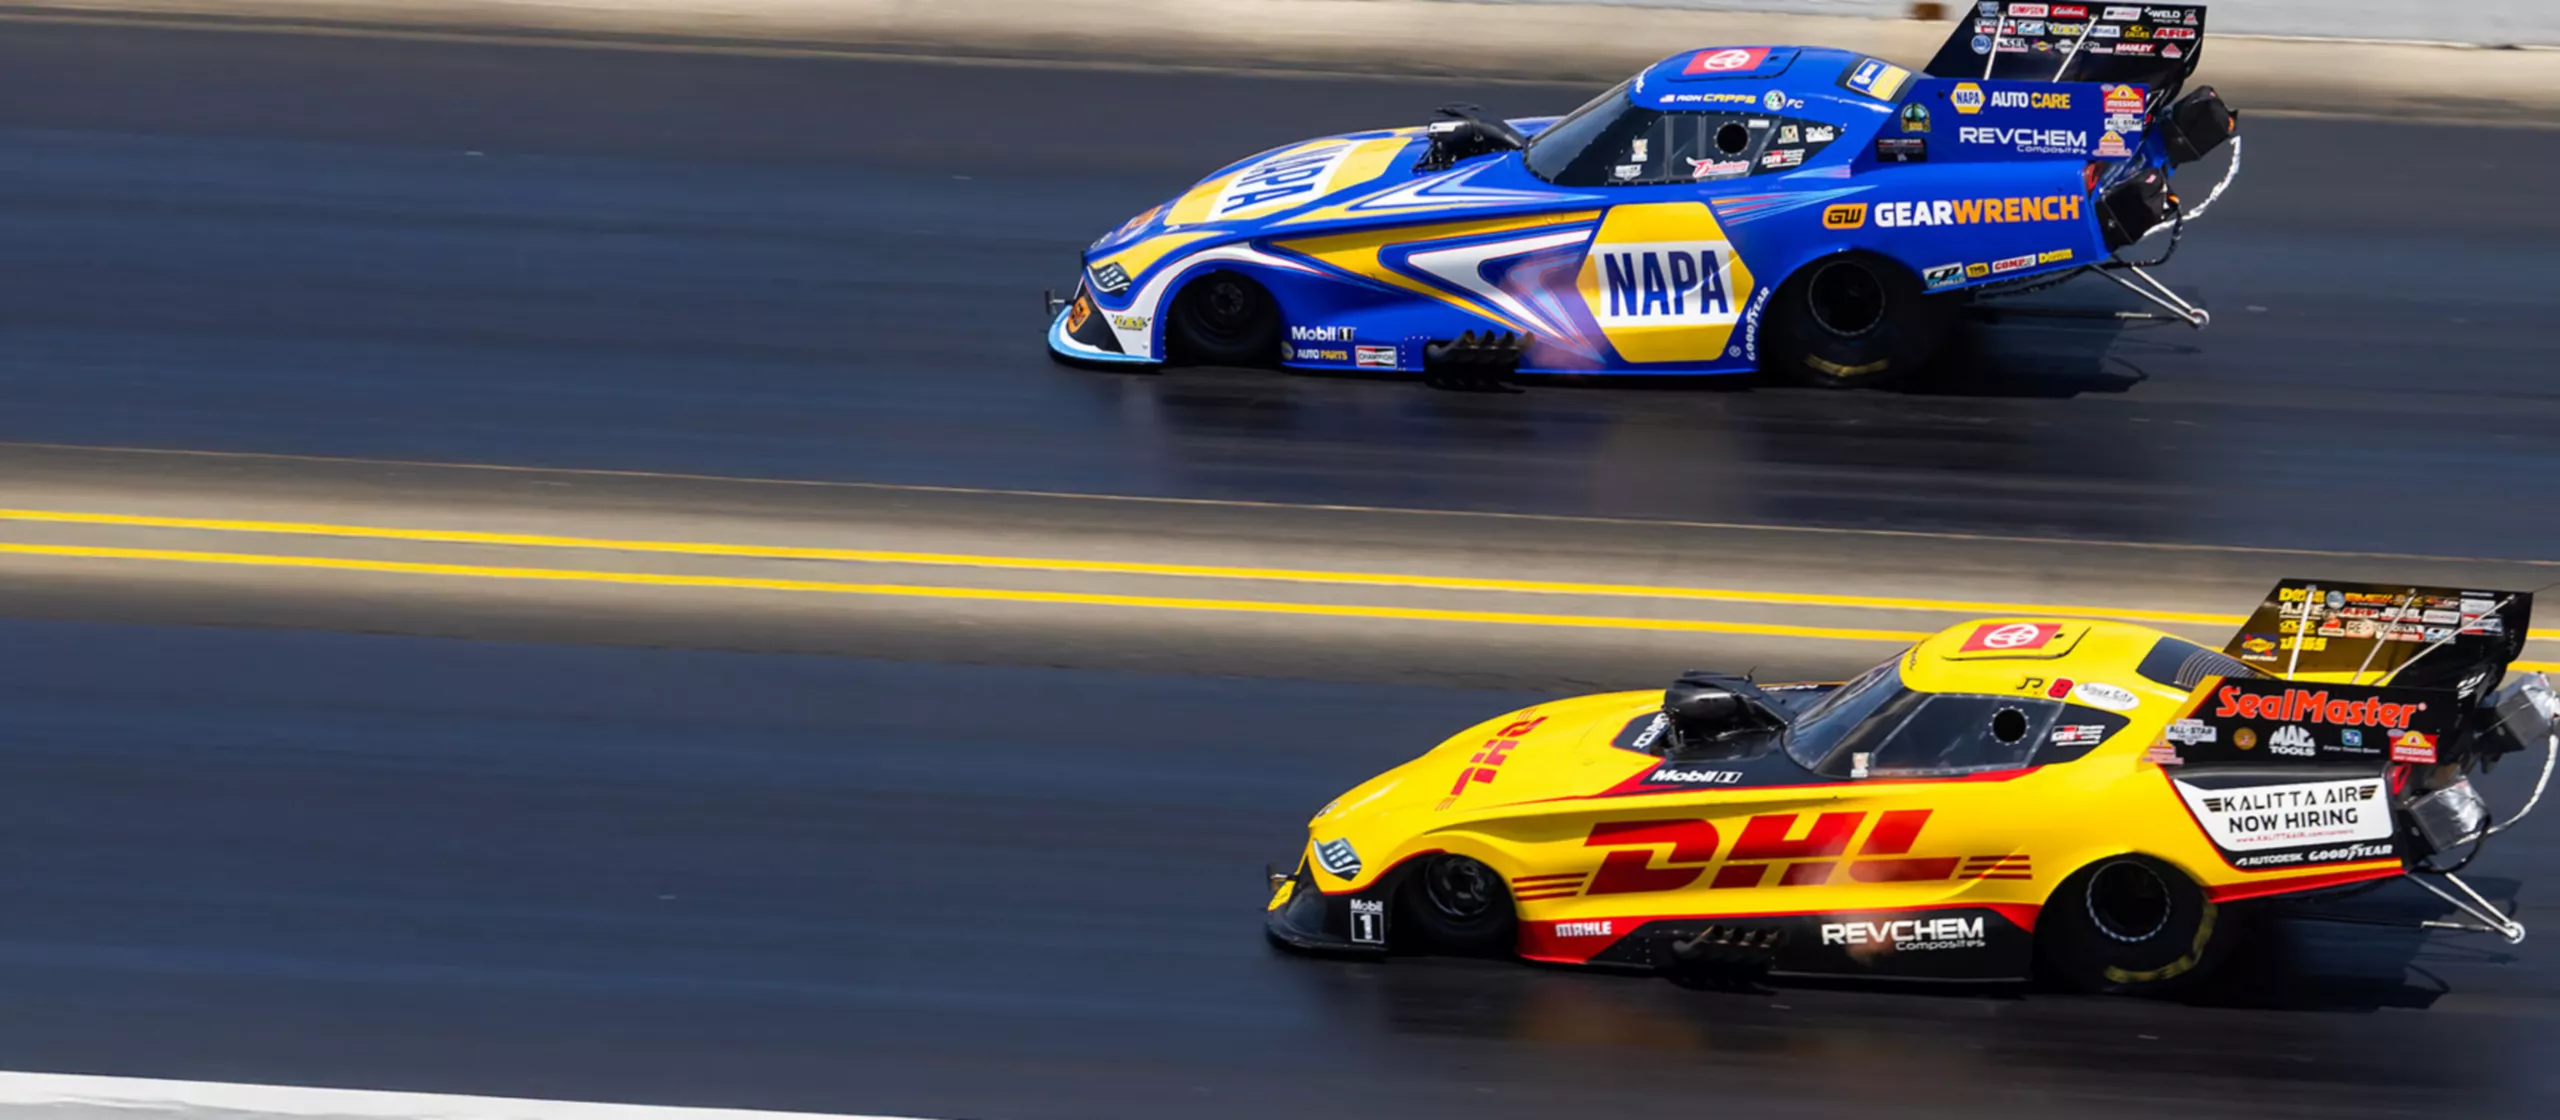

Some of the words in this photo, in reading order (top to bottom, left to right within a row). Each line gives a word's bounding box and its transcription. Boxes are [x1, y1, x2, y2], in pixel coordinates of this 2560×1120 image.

[2151, 10, 2180, 18] WELD
[2156, 28, 2194, 38] ARP
[1676, 94, 1702, 102] RON
[1703, 93, 1757, 104] CAPPS
[1786, 99, 1804, 109] FC
[1956, 91, 1981, 106] NAPA
[1991, 91, 2028, 107] AUTO
[2031, 93, 2071, 109] CARE
[1959, 127, 2087, 148] REVCHEM
[2016, 145, 2087, 155] Composites
[1220, 144, 1345, 215] NAPA
[1874, 196, 2081, 228] GEARWRENCH
[1604, 250, 1729, 316] NAPA
[1746, 286, 1770, 361] GOODYEAR
[1291, 325, 1336, 341] Mobil
[1297, 349, 1319, 359] AUTO
[1320, 350, 1347, 360] PARTS
[2216, 685, 2417, 729] SealMaster
[2269, 725, 2316, 747] MAC
[1450, 715, 1550, 796] DHL
[2269, 746, 2316, 757] TOOLS
[1651, 769, 1718, 782] Mobil
[2224, 791, 2317, 812] KALITTA
[2324, 786, 2358, 803] AIR
[2228, 814, 2279, 834] NOW
[2284, 808, 2358, 830] HIRING
[1584, 808, 1962, 896] DHL
[2249, 852, 2304, 864] AUTODESK
[2308, 843, 2394, 861] GOODYEAR
[1350, 899, 1383, 911] Mobil
[1555, 920, 1612, 937] MAHLE
[1821, 916, 1985, 946] REVCHEM
[1895, 938, 1986, 951] Composites
